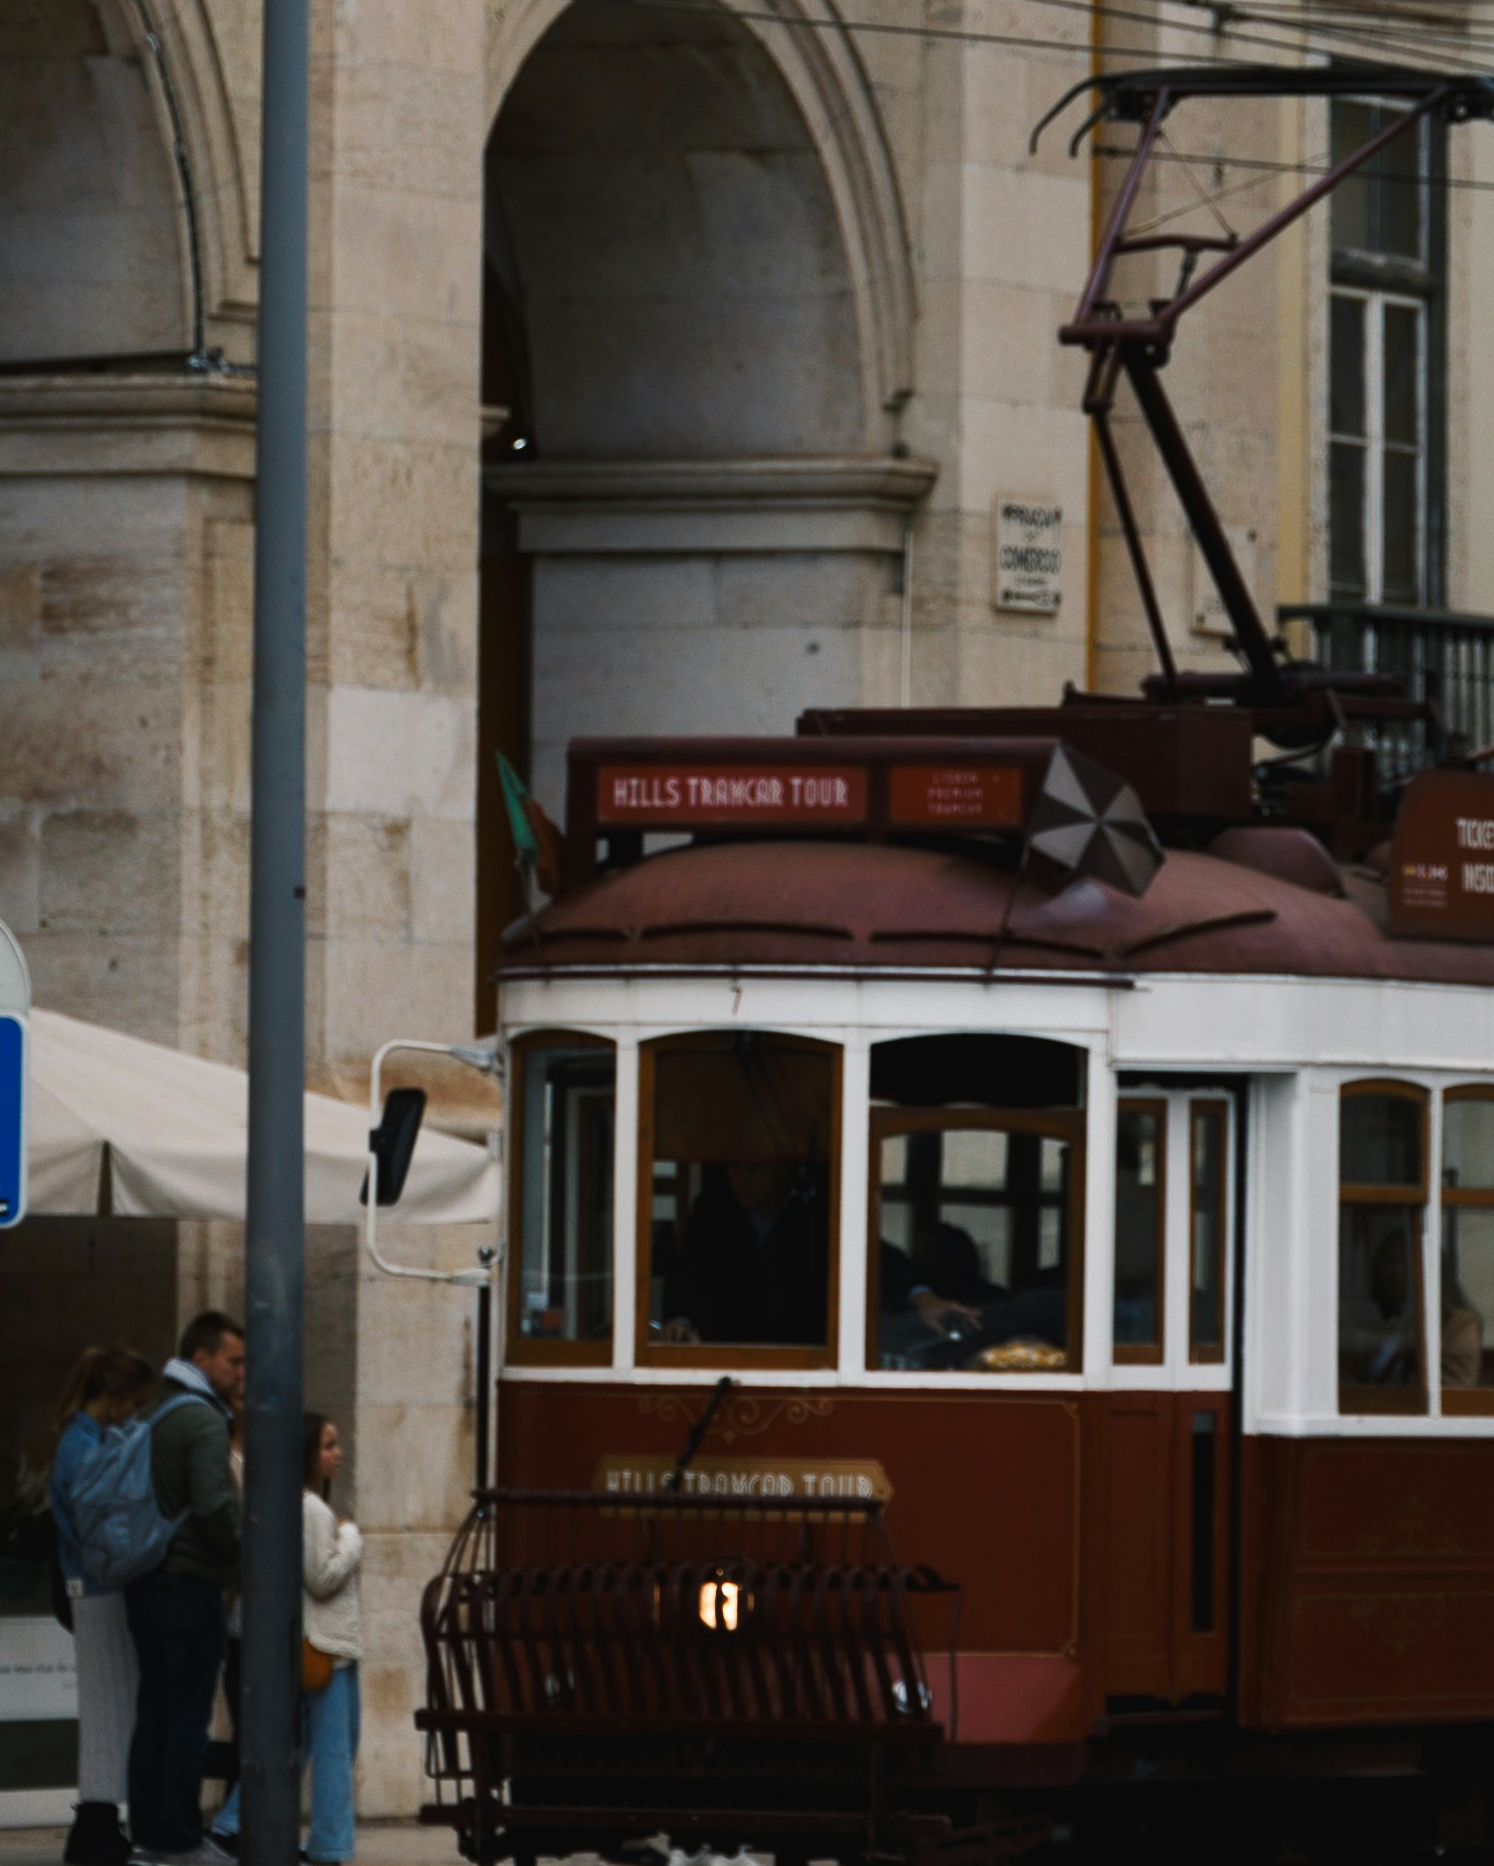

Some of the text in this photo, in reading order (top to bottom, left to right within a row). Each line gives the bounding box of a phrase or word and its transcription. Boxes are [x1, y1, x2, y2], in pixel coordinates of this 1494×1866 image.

[613, 776, 849, 808] HILLS TRAMCAR TOUR
